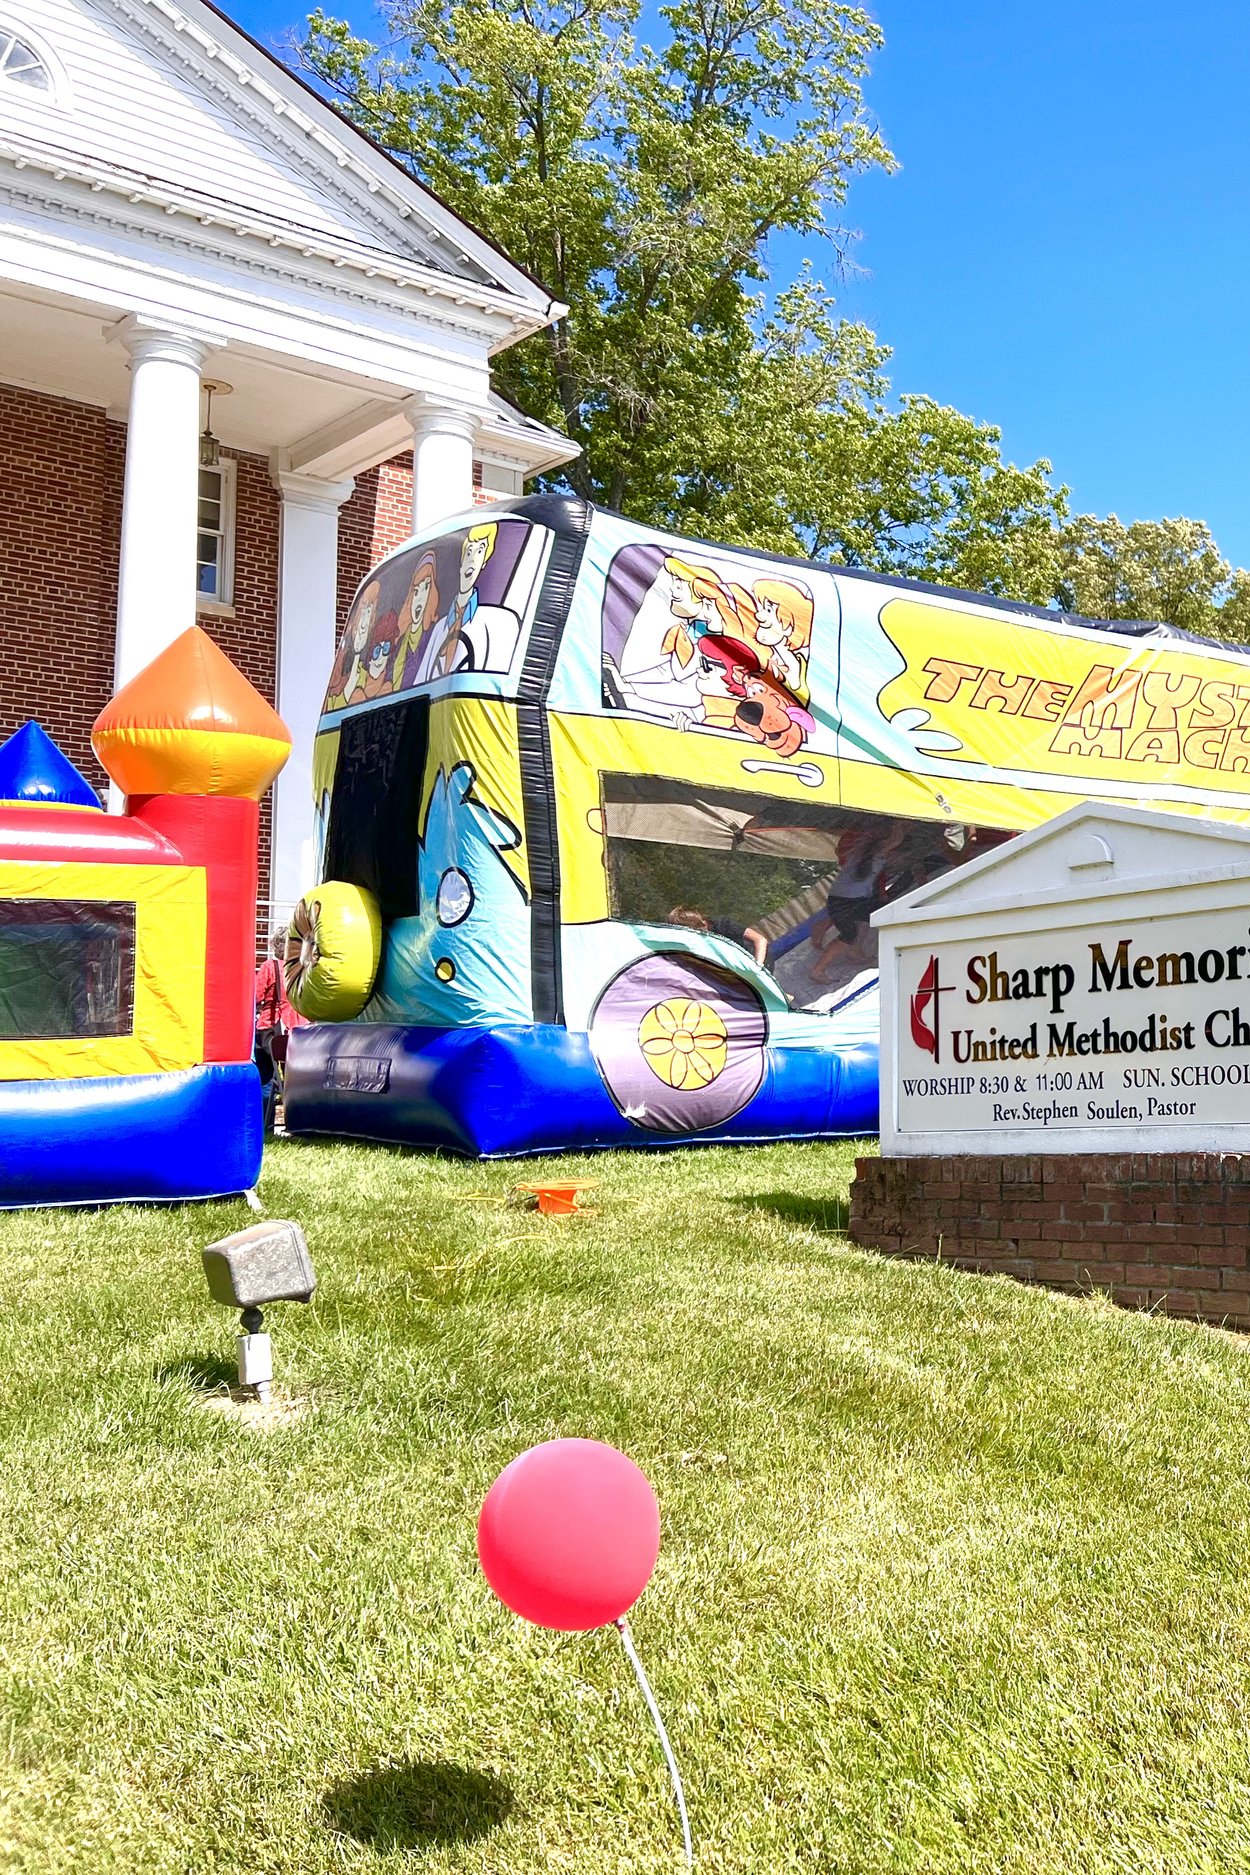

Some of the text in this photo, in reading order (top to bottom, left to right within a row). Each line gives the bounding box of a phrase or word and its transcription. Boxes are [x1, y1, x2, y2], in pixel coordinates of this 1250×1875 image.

[922, 657, 1074, 721] THE
[965, 951, 1075, 1013] Sharp
[951, 1022, 1038, 1063] United
[1047, 1013, 1196, 1058] Methodist
[902, 1077, 975, 1097] WORSHIP
[979, 1075, 1009, 1095] 8:30
[1014, 1075, 1028, 1093] &
[1035, 1071, 1073, 1092] 11:00
[1076, 1071, 1104, 1091] AM
[1123, 1067, 1166, 1089] SUN.
[1086, 1099, 1144, 1122] Soulen,
[1146, 1097, 1197, 1117] Pastor
